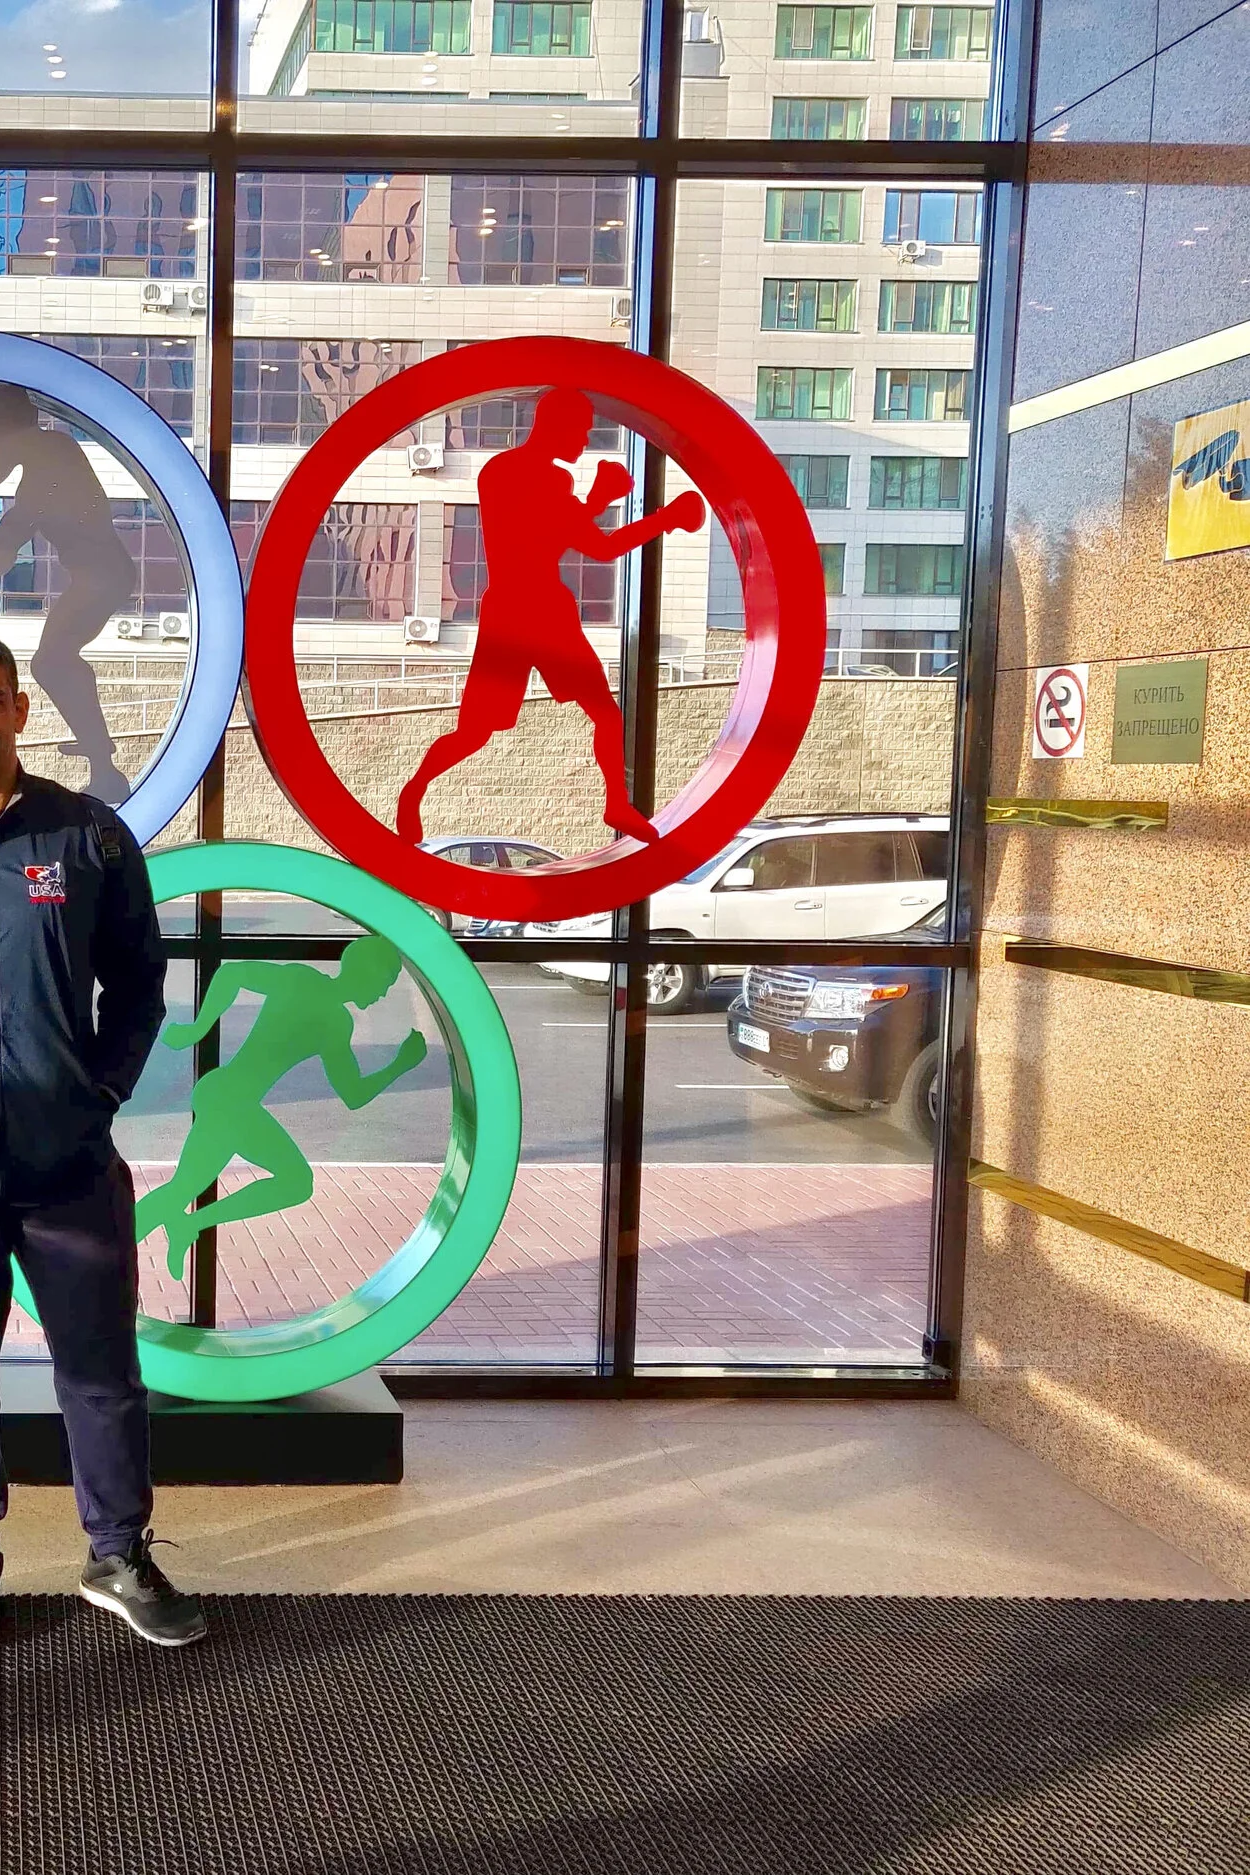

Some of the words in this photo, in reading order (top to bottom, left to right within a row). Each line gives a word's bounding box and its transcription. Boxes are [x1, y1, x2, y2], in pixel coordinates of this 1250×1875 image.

[1134, 686, 1184, 704] КУРИТЬ
[1117, 718, 1199, 737] ЗАПРЕЩЕНО
[29, 884, 65, 897] USA
